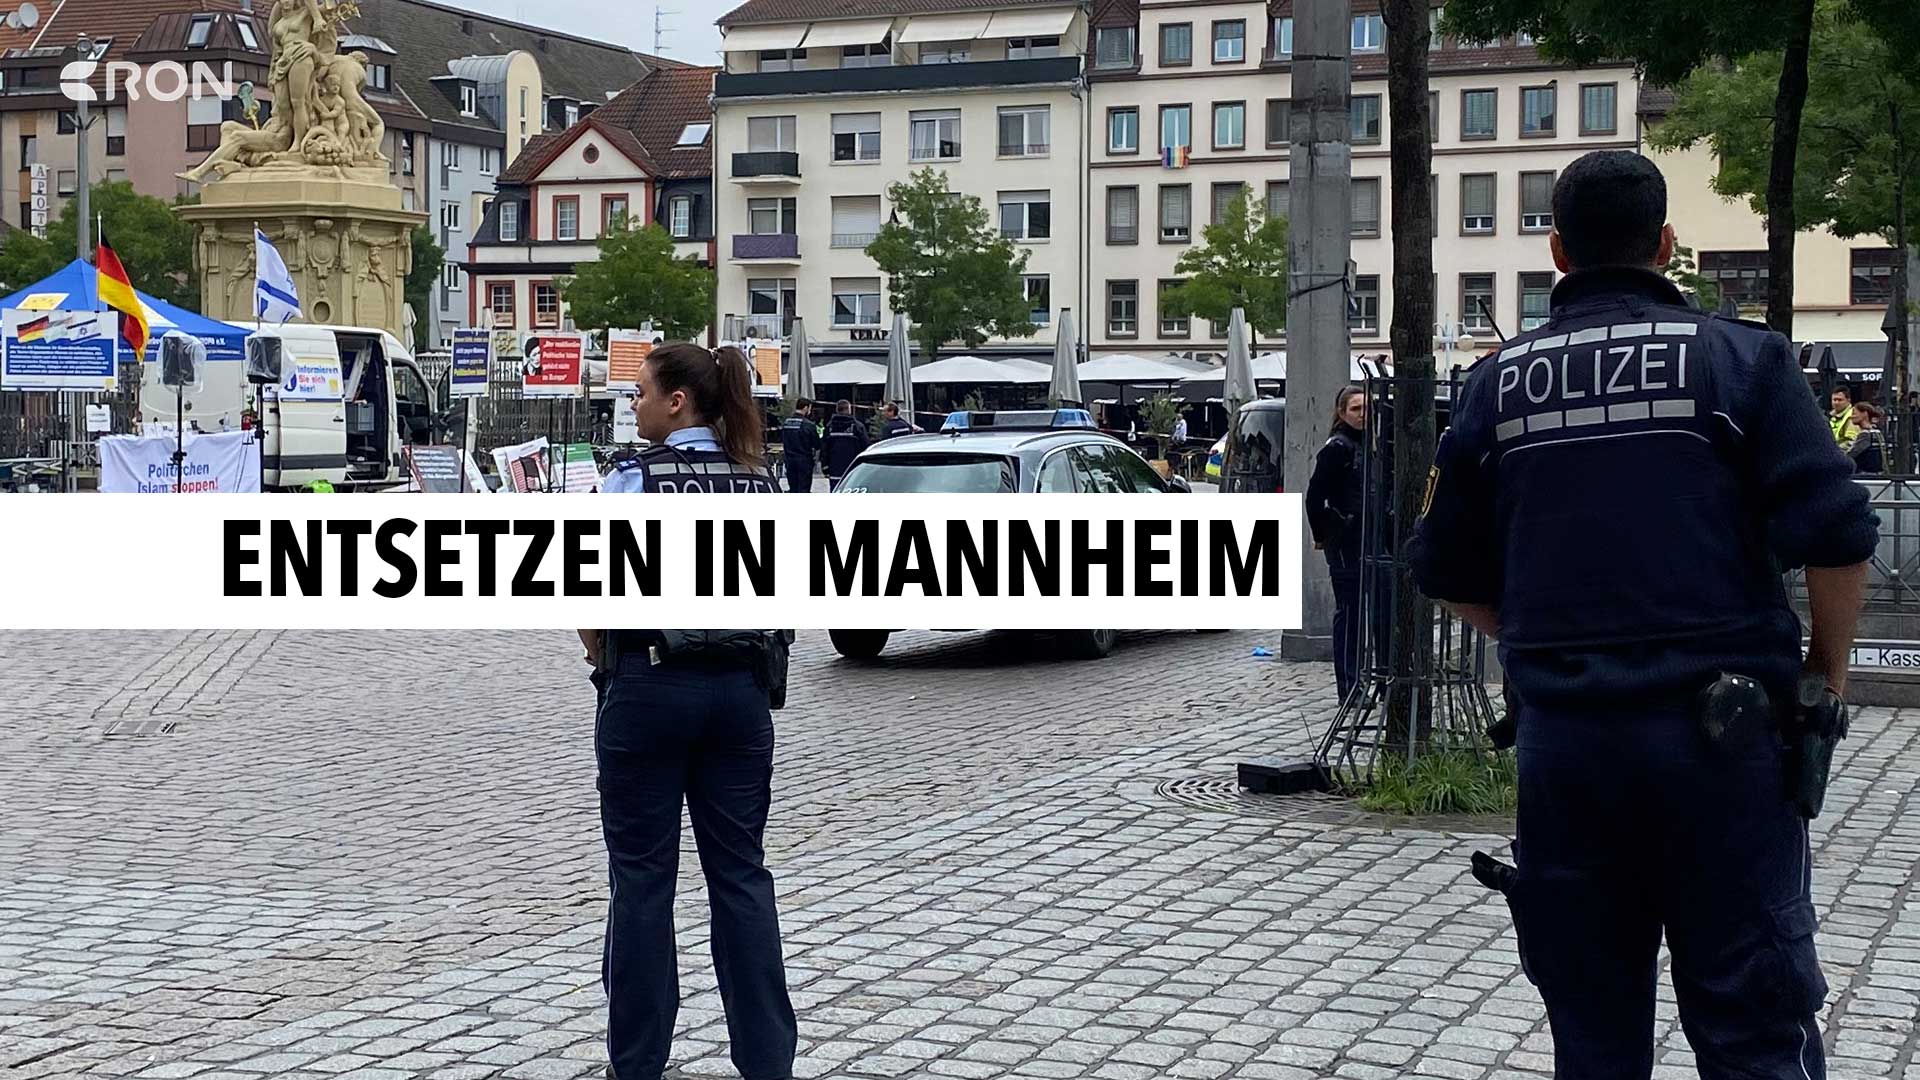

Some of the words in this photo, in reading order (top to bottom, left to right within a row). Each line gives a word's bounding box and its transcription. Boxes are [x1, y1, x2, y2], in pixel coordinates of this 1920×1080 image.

[1497, 342, 1687, 413] POLIZEI
[148, 462, 210, 478] Politichen
[171, 476, 218, 493] soppen!
